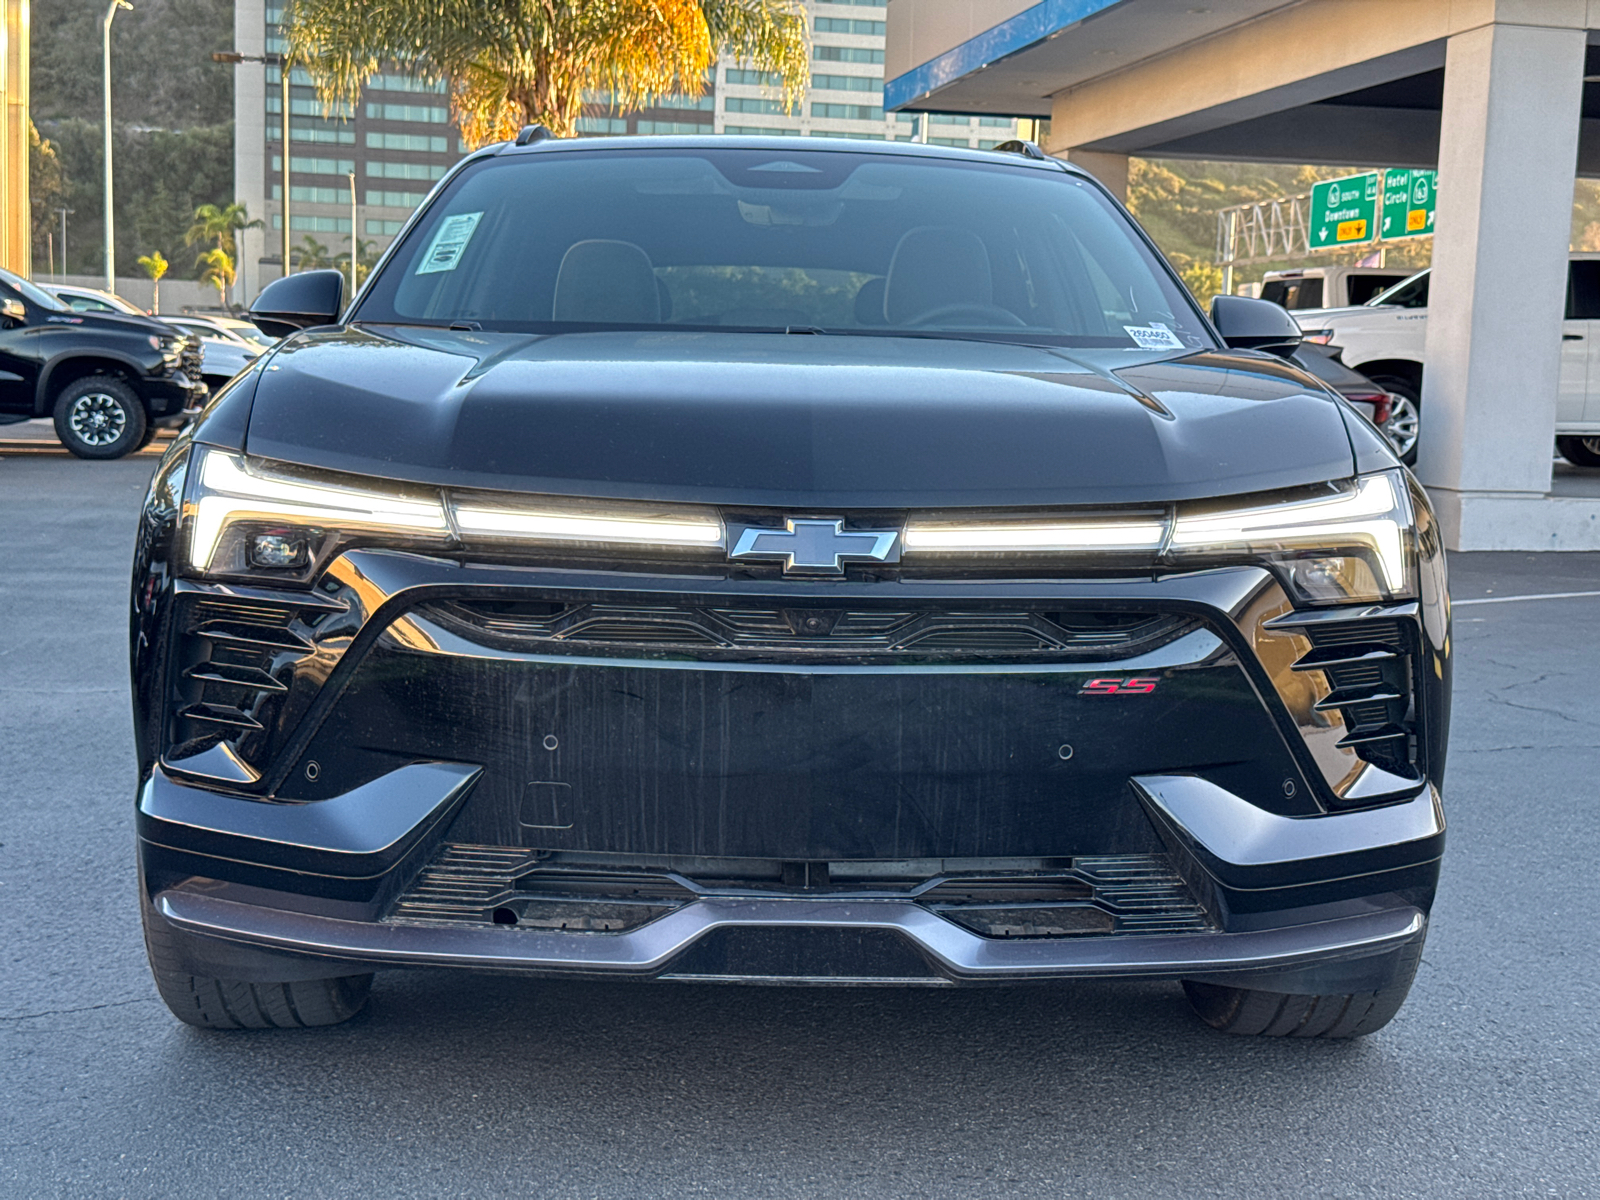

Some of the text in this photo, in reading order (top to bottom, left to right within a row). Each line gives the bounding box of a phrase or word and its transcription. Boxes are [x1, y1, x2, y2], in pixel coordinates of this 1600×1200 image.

[1387, 173, 1408, 188] Hotel
[1341, 190, 1359, 202] SOUTH
[1385, 191, 1407, 205] Circle
[1414, 187, 1427, 199] 163
[1325, 208, 1359, 223] Downtown
[1077, 677, 1160, 694] SS
